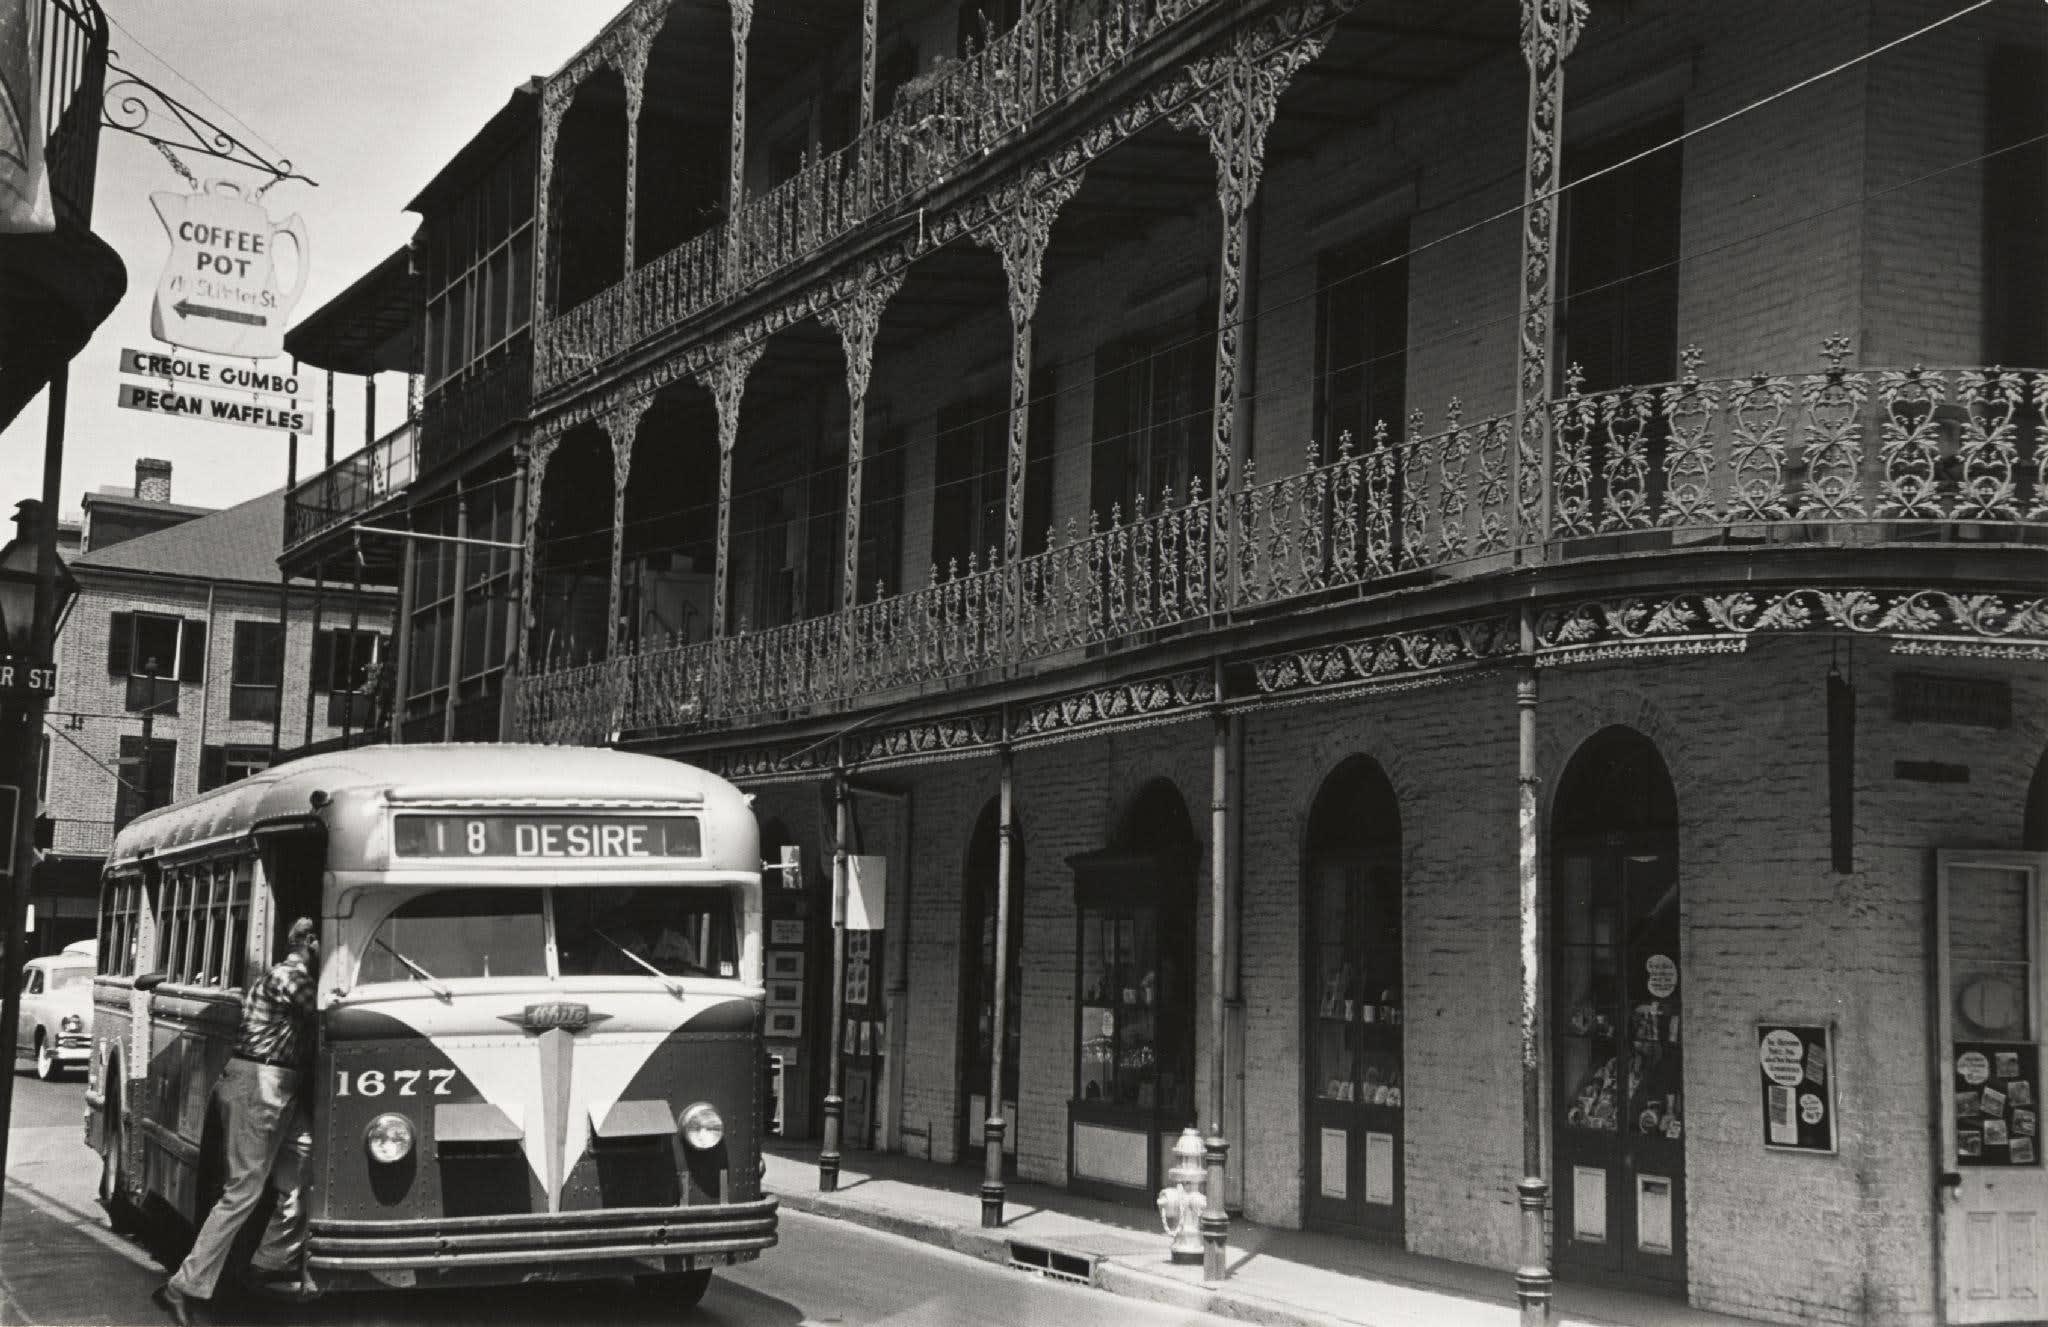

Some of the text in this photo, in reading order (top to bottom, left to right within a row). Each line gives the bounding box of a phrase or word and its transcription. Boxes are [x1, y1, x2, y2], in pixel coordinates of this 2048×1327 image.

[179, 221, 264, 254] COFFEE
[197, 252, 251, 278] POT
[133, 354, 299, 395] CREOLE GUMBO
[132, 388, 304, 431] PECAN WAFFLES
[515, 824, 649, 857] DESIRE
[336, 1069, 456, 1097] 1677
